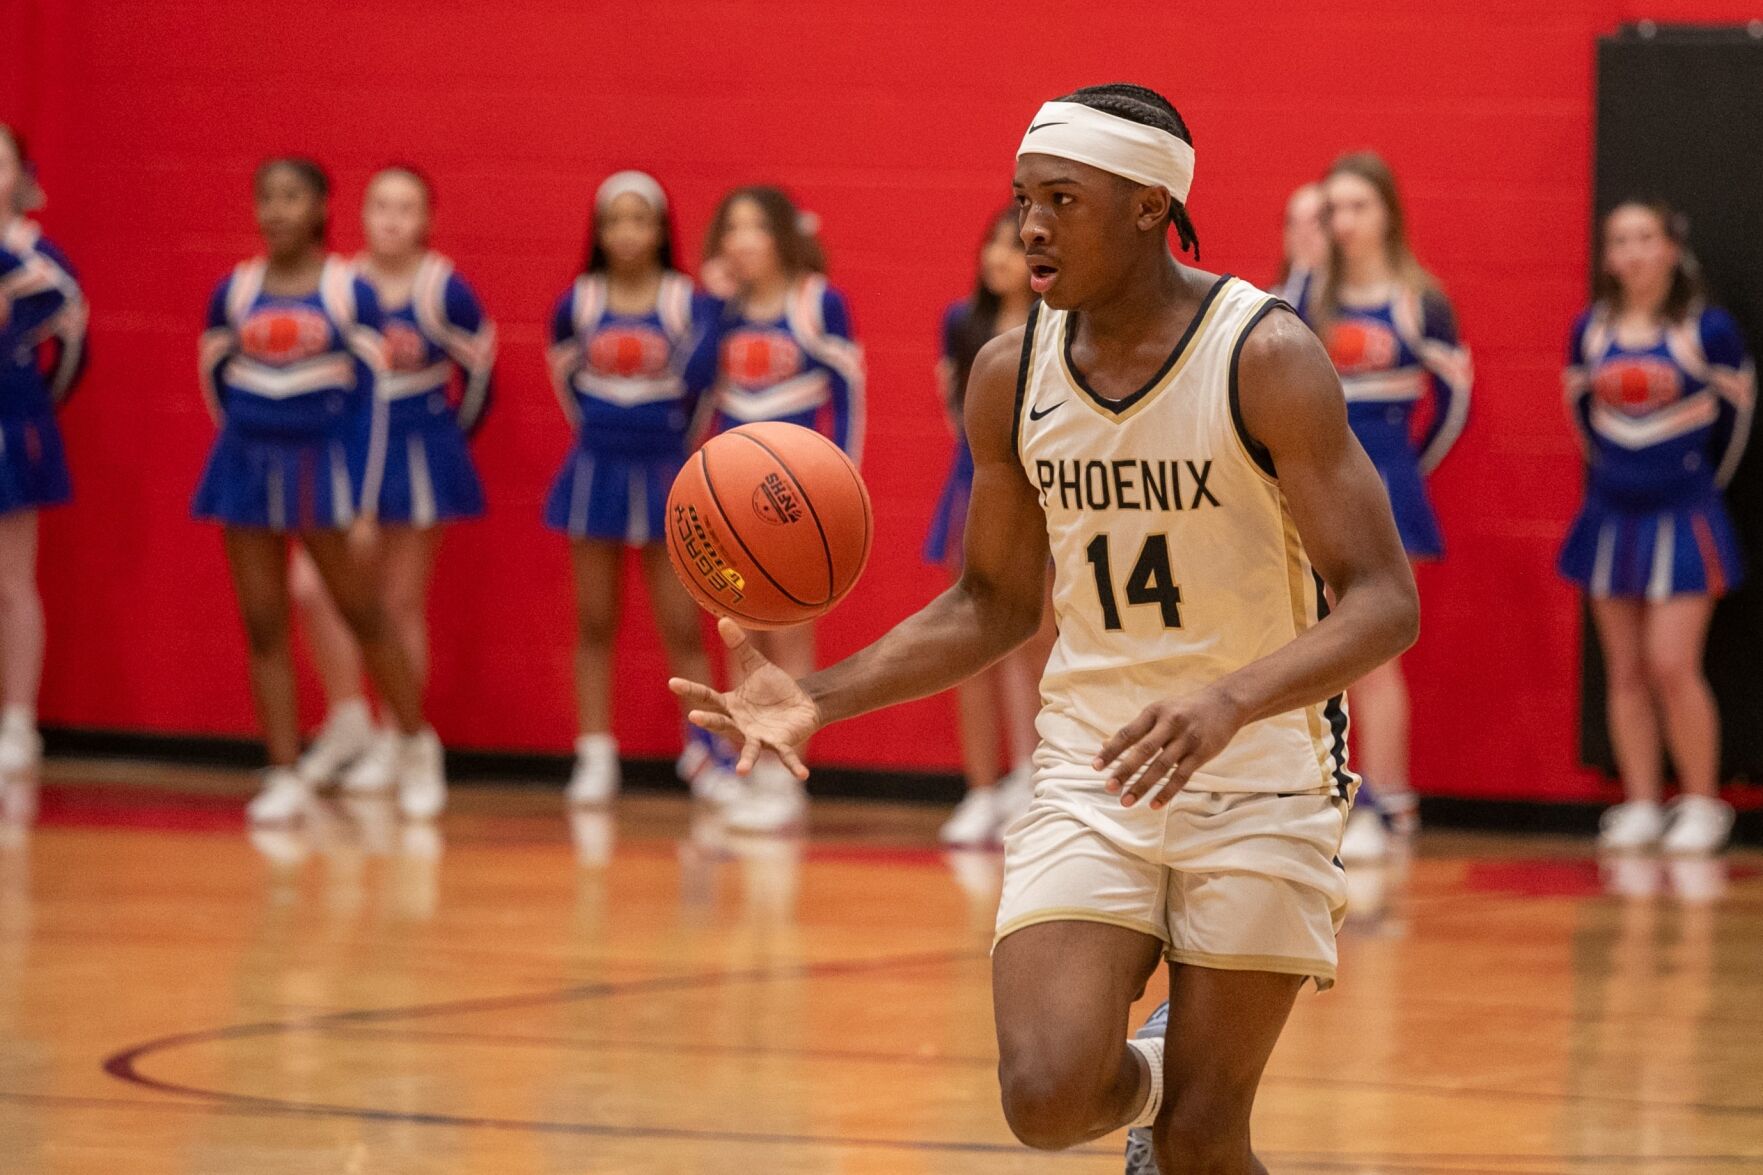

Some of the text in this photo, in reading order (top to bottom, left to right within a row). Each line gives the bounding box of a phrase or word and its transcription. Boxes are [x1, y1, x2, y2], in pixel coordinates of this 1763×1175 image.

[765, 472, 797, 512] NFHS
[1036, 459, 1221, 511] PHOENIX
[675, 504, 744, 604] LEGACY
[1086, 532, 1183, 632] 14
